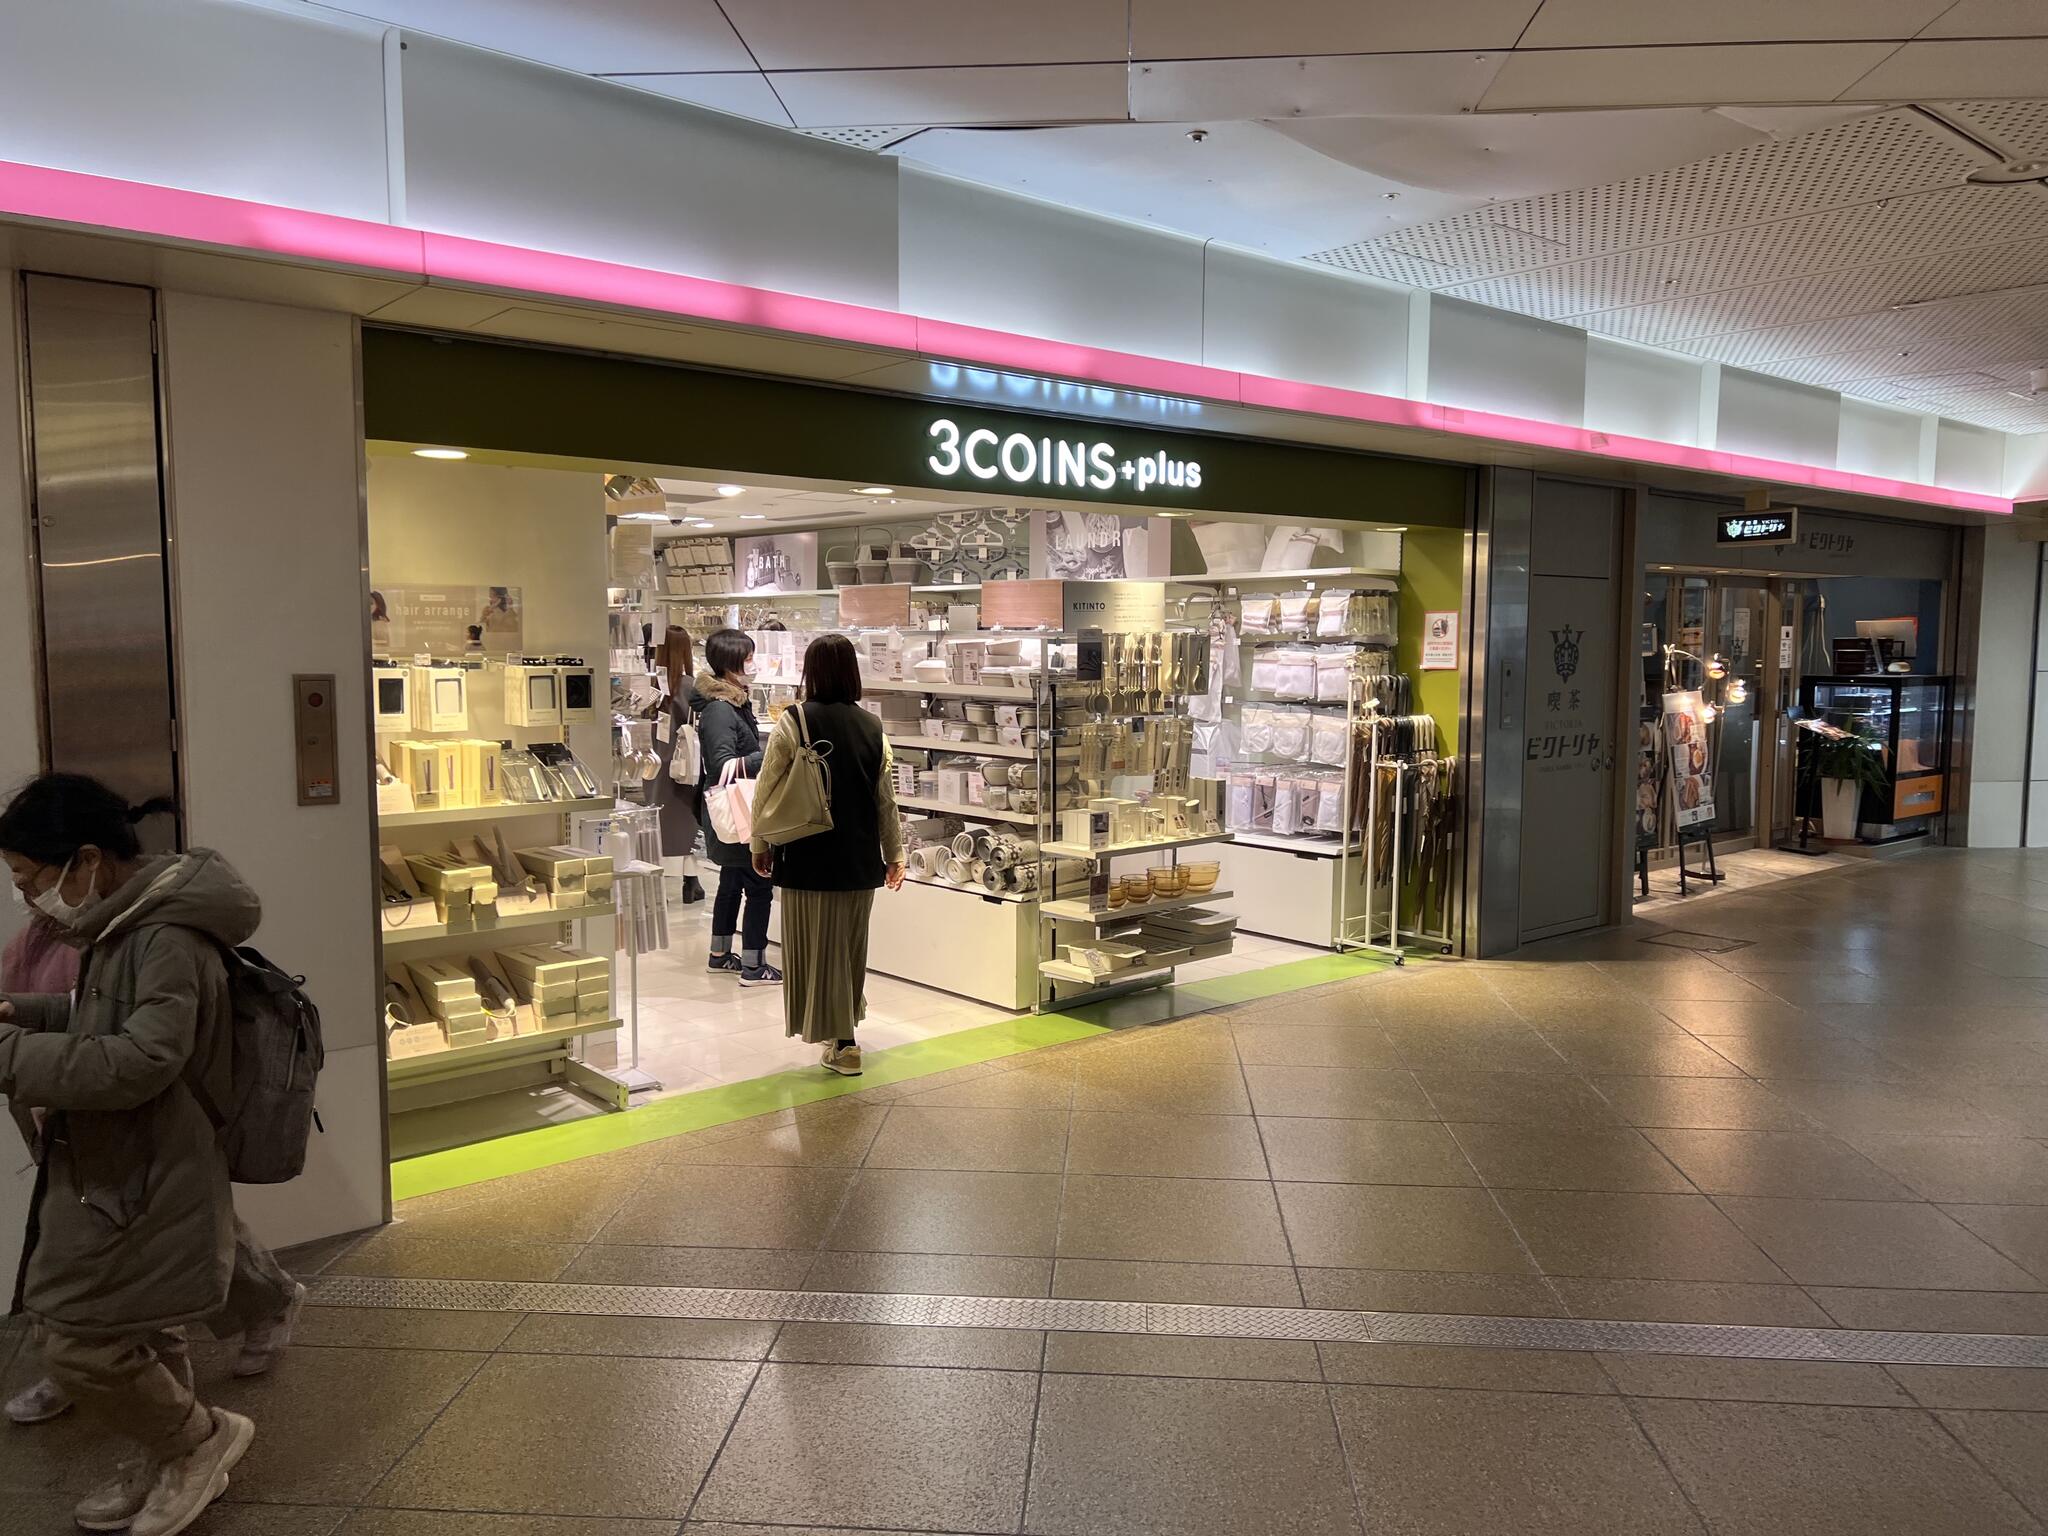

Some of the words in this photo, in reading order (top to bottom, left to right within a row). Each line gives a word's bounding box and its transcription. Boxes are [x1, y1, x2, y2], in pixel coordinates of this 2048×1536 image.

[1744, 523, 1785, 533] ビクトリヤ
[1055, 531, 1133, 550] LAUNDRY
[1809, 532, 1854, 552] ビクトリヤ
[758, 555, 785, 570] BATH
[396, 604, 419, 616] hair
[424, 607, 470, 619] arrange
[1073, 602, 1105, 611] KITINTO
[1545, 719, 1582, 730] VICTORIA
[1527, 733, 1600, 761] ビクトリヤ
